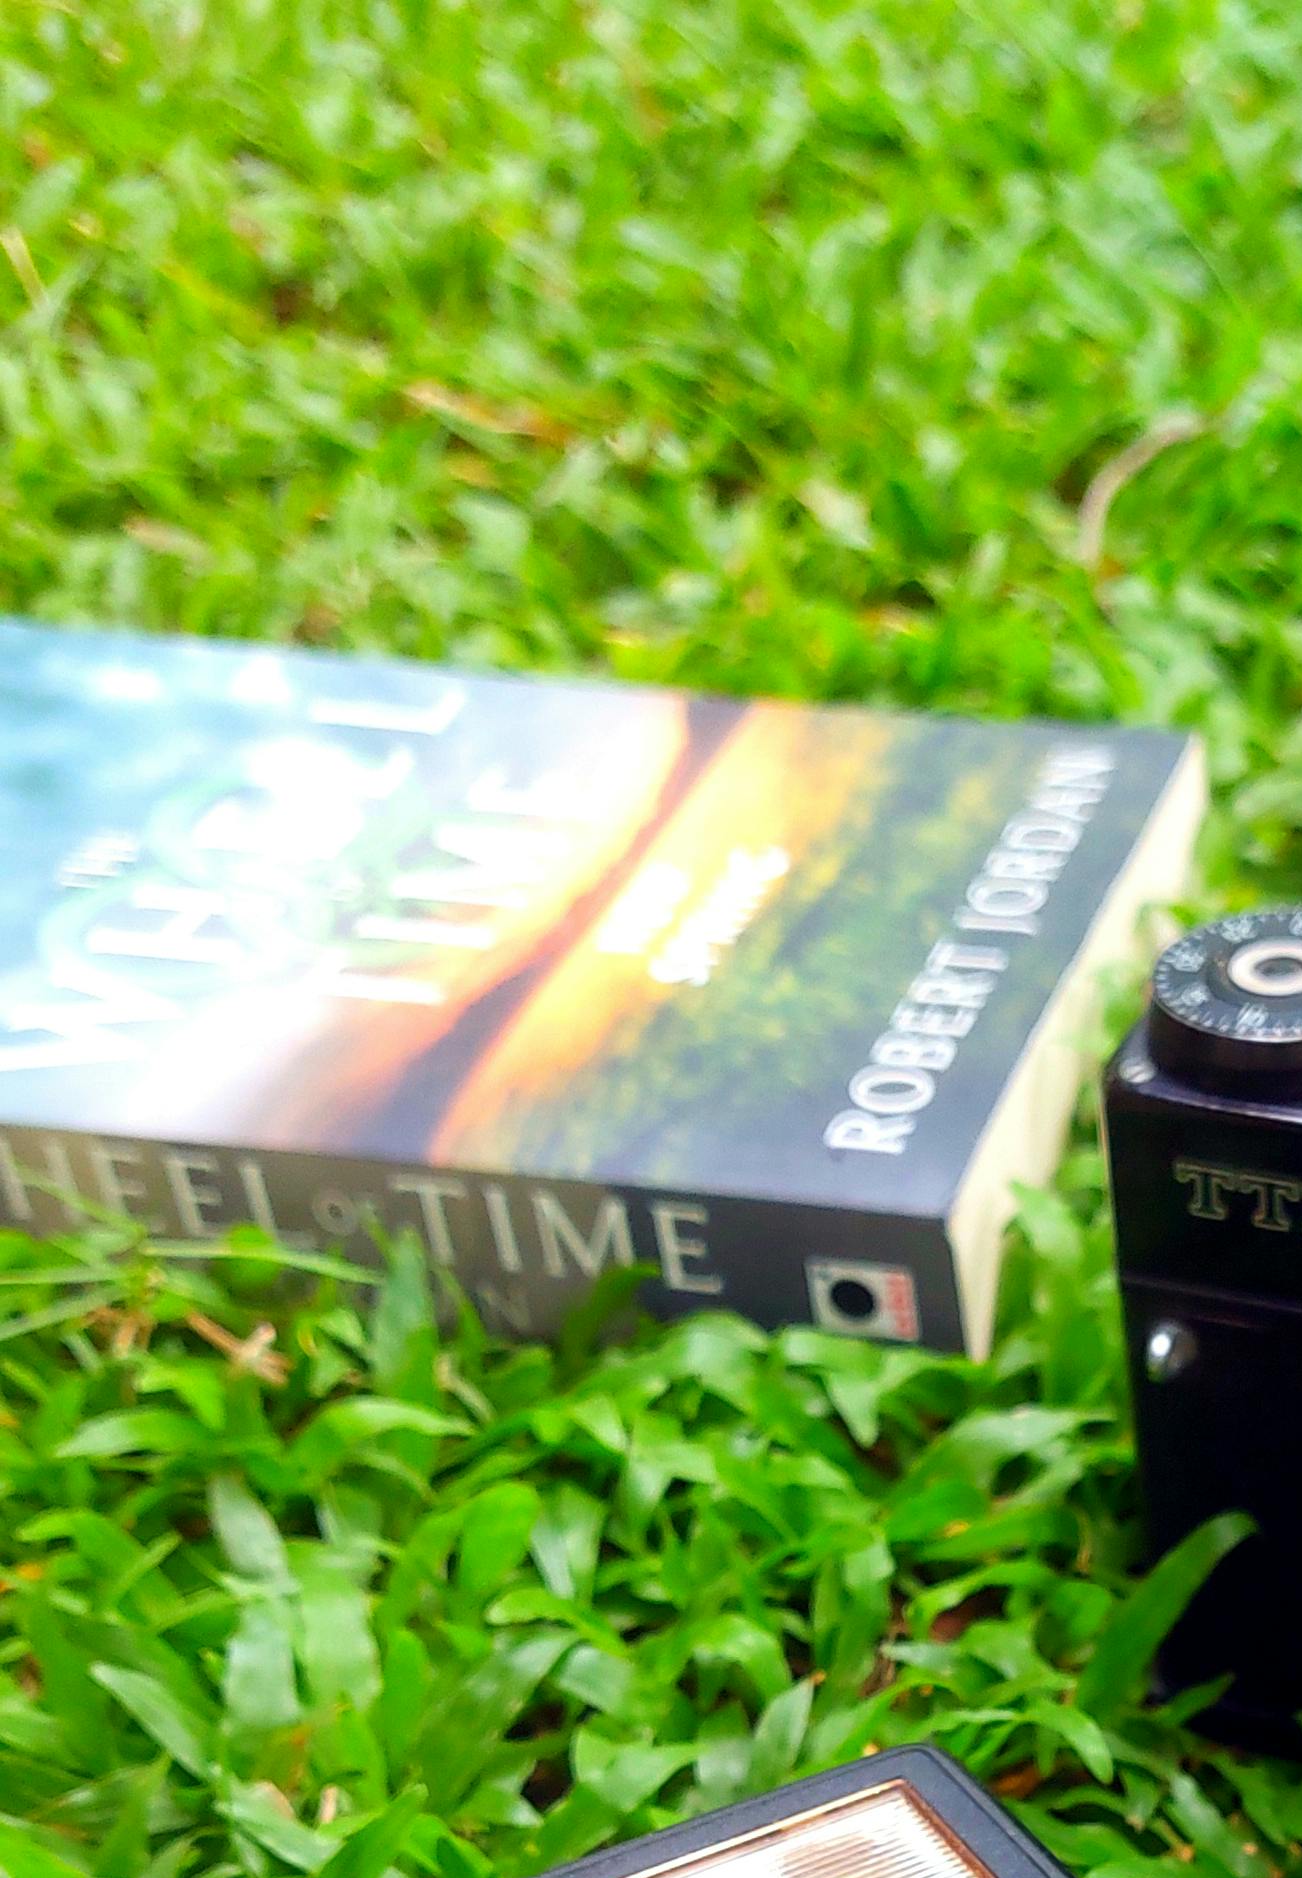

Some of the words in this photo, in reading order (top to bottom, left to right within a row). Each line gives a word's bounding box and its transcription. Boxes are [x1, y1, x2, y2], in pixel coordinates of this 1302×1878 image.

[822, 938, 1010, 1156] ROBERT
[953, 741, 1115, 936] JORDAN
[388, 1172, 725, 1295] TIME
